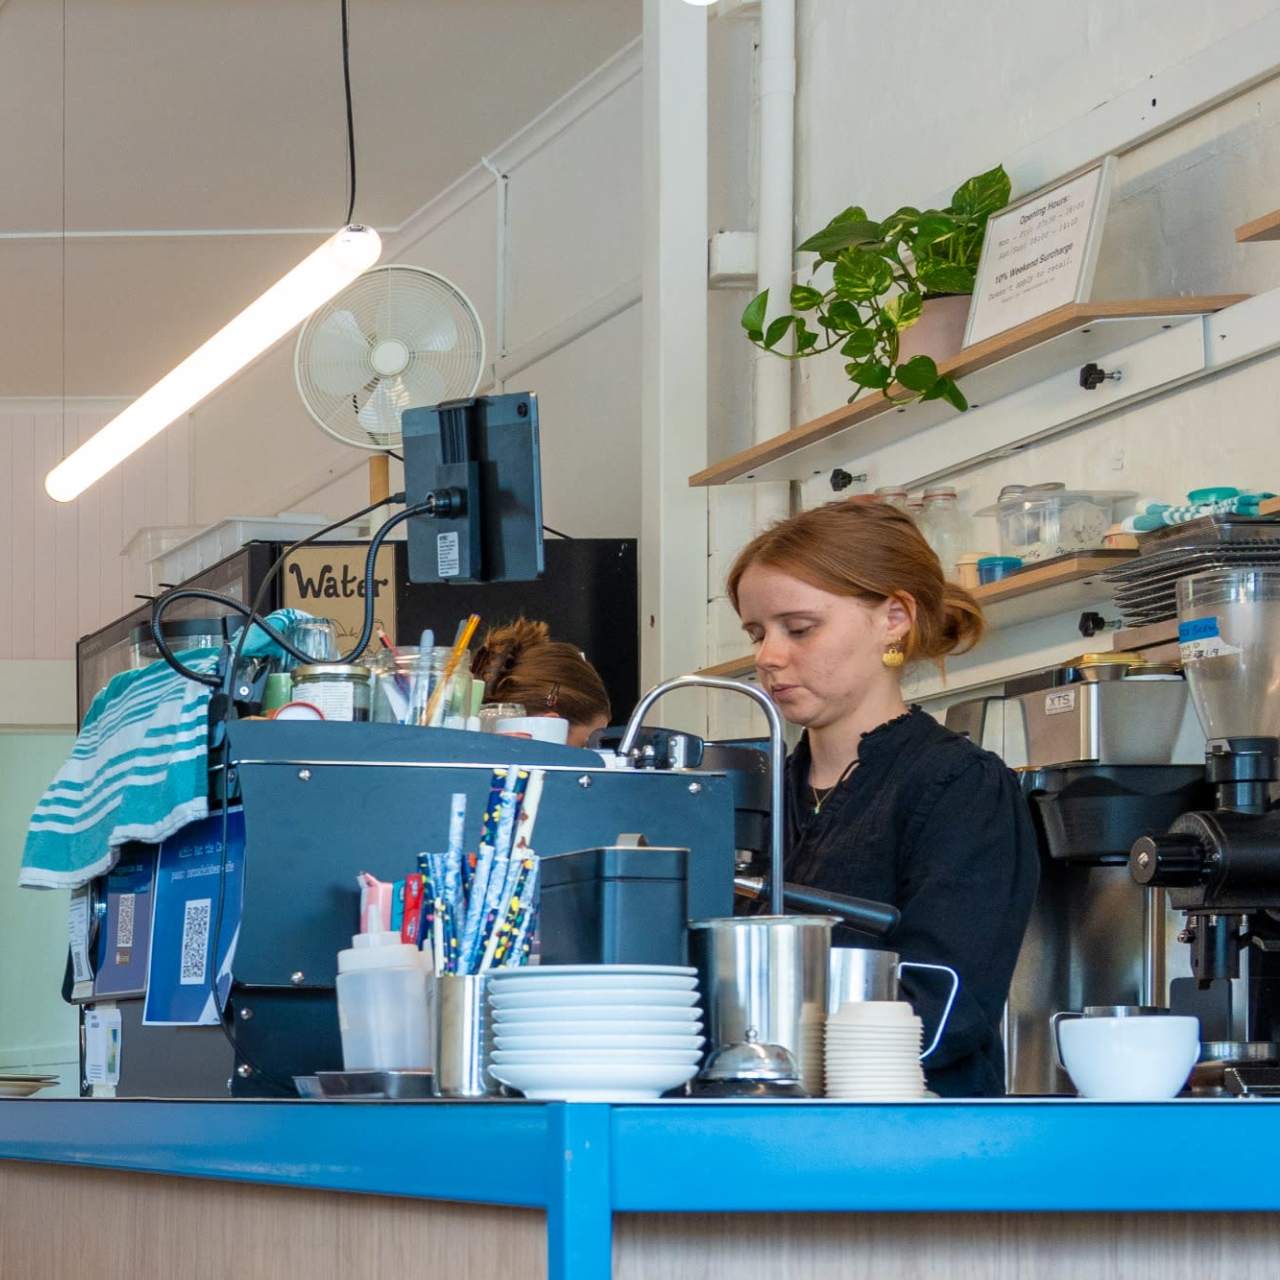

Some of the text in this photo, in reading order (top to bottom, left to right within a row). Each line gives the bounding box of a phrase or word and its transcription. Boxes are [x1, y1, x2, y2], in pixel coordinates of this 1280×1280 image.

[1020, 206, 1047, 224] Opening
[1009, 258, 1039, 279] Weekend
[1039, 242, 1074, 264] Surcharge
